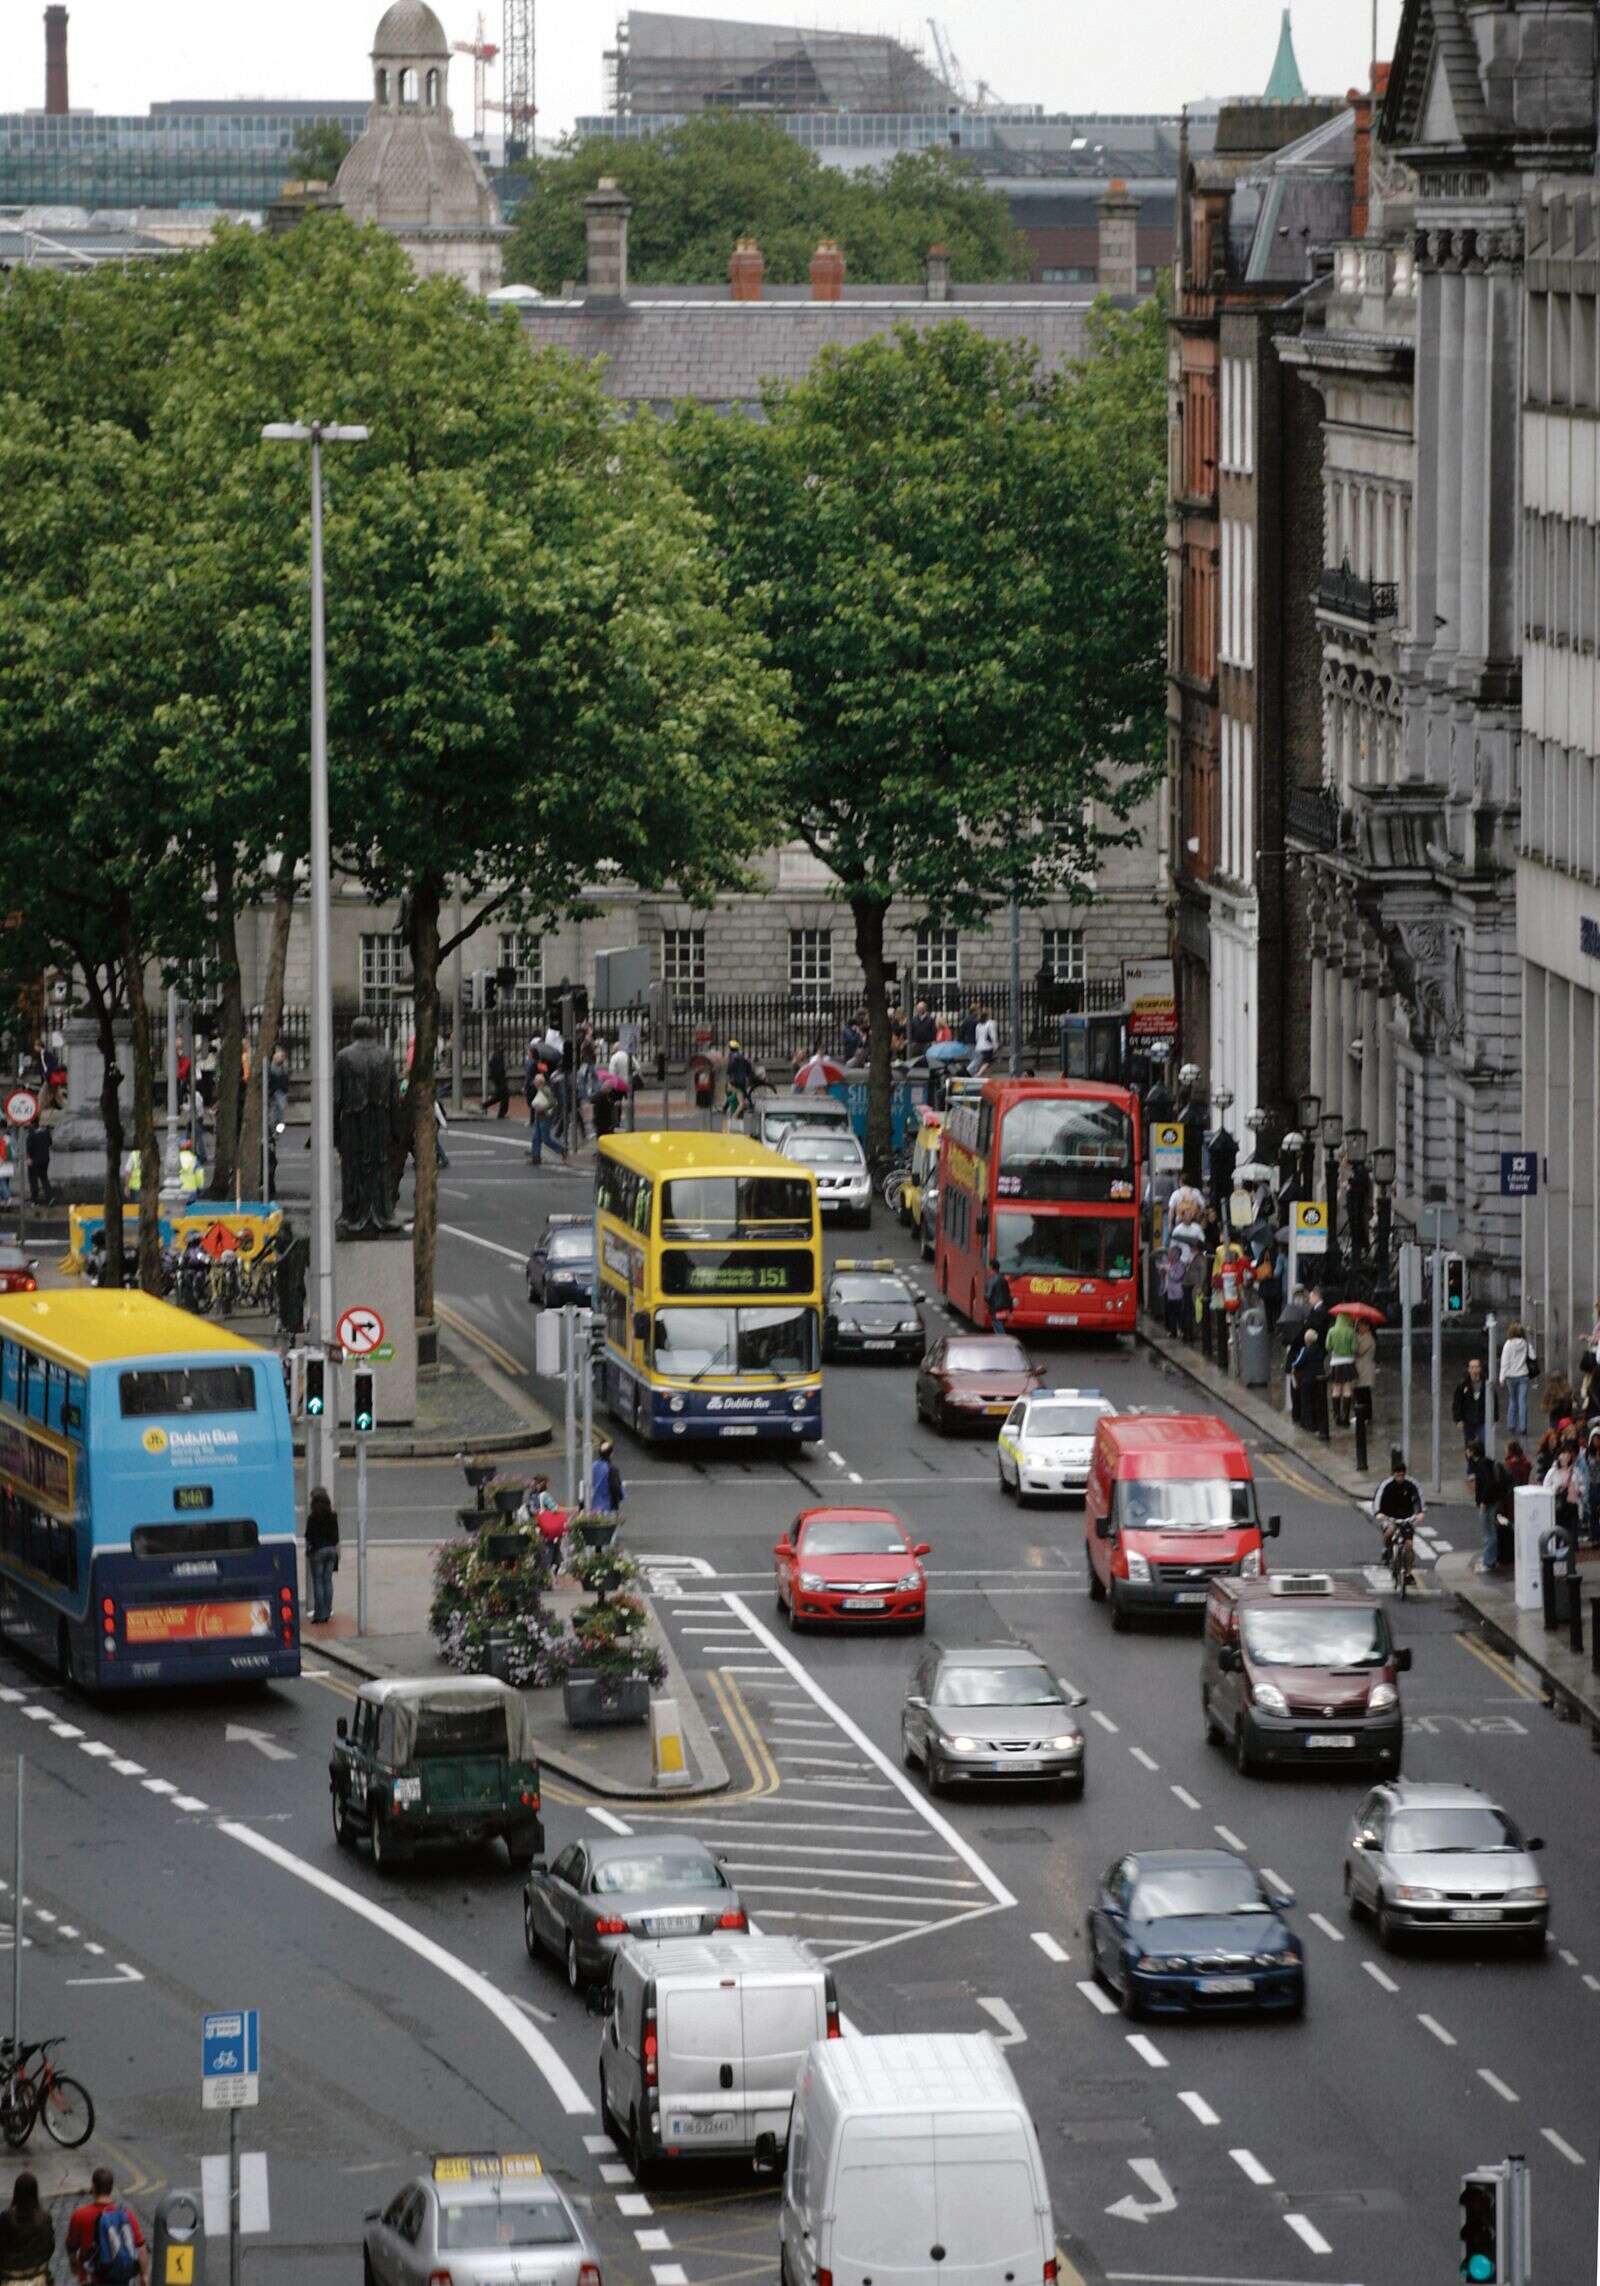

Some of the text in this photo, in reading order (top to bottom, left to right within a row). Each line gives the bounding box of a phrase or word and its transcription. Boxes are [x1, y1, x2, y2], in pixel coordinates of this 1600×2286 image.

[1509, 1183, 1528, 1191] Bank
[759, 1267, 788, 1287] 151
[723, 1396, 771, 1409] Dublin Bus
[170, 1428, 239, 1446] Dublin Bus
[230, 1655, 270, 1668] VOLVO
